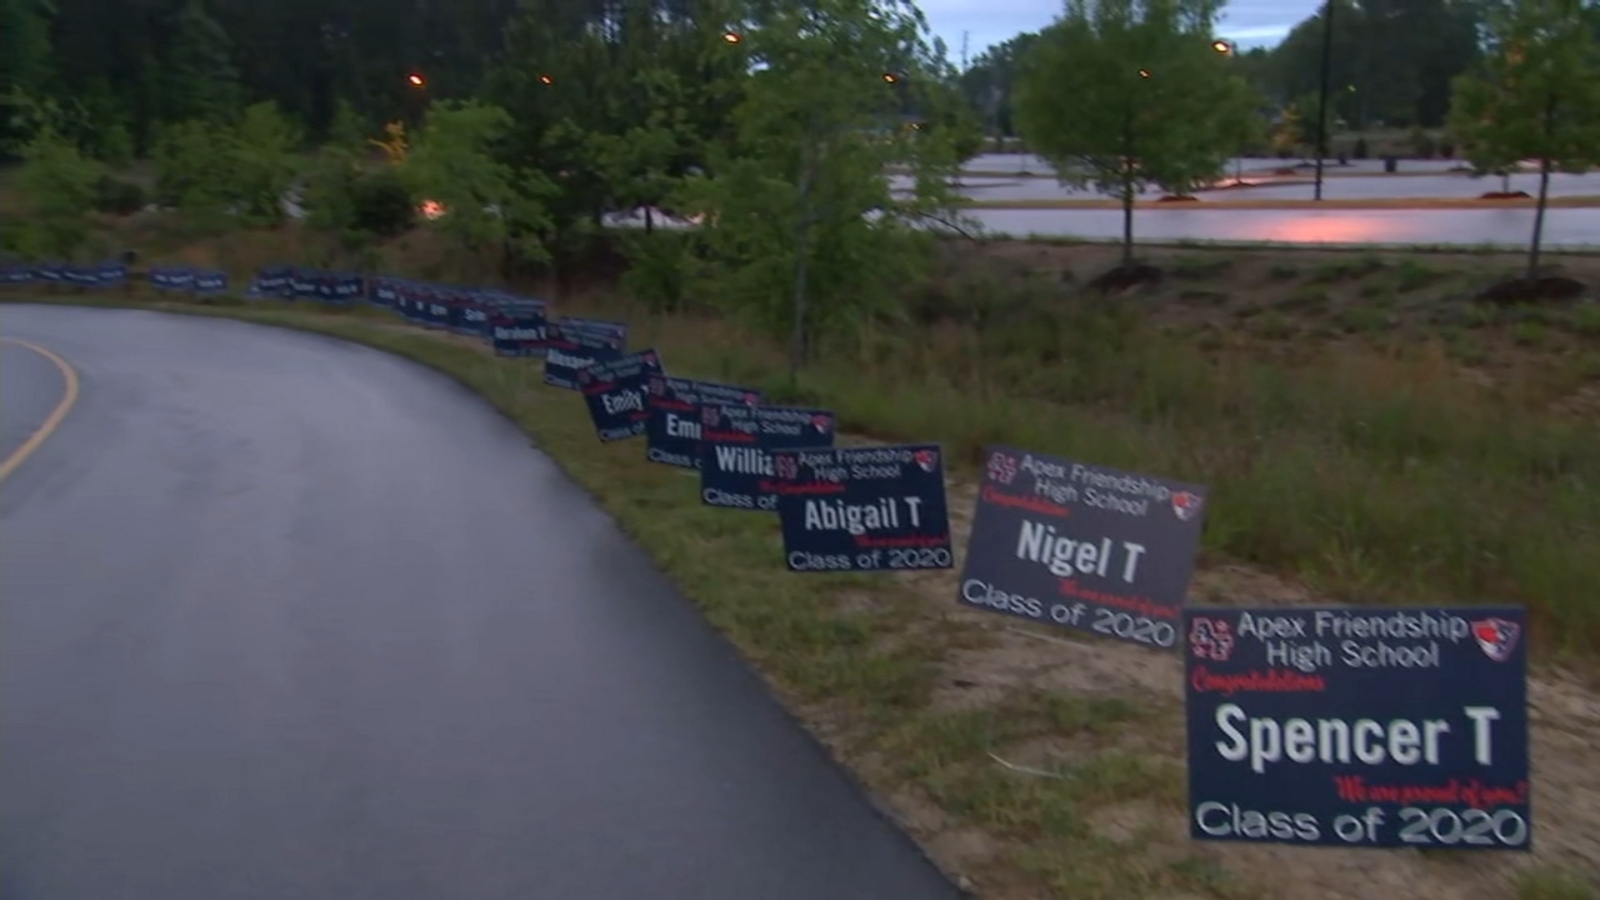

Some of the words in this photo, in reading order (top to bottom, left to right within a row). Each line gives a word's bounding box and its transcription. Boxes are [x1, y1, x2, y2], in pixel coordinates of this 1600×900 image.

[601, 389, 644, 414] Emily
[799, 452, 833, 467] Apex
[836, 450, 913, 464] Friendship
[814, 466, 849, 483] High
[852, 464, 902, 480] School
[1020, 454, 1065, 482] Apex
[1071, 464, 1171, 502] Friendship
[1034, 478, 1079, 504] High
[1084, 488, 1149, 516] School
[703, 488, 754, 508] Class
[804, 497, 899, 535] Abigail
[904, 496, 923, 528] T
[788, 550, 852, 571] Class
[856, 549, 883, 568] of
[887, 548, 951, 568] 2020
[1016, 519, 1113, 577] Nigel
[1122, 541, 1147, 583] T
[962, 578, 1043, 618] Class
[1050, 602, 1086, 626] of
[1092, 607, 1176, 648] 2020
[1237, 611, 1307, 648] Apex
[1314, 610, 1470, 644] Friendship
[1266, 641, 1332, 673] High
[1340, 640, 1440, 668] School
[1214, 703, 1451, 774] Spencer
[1463, 706, 1501, 766] T
[1195, 801, 1321, 841] Class
[1333, 806, 1386, 842] of
[1398, 807, 1527, 846] 2020
